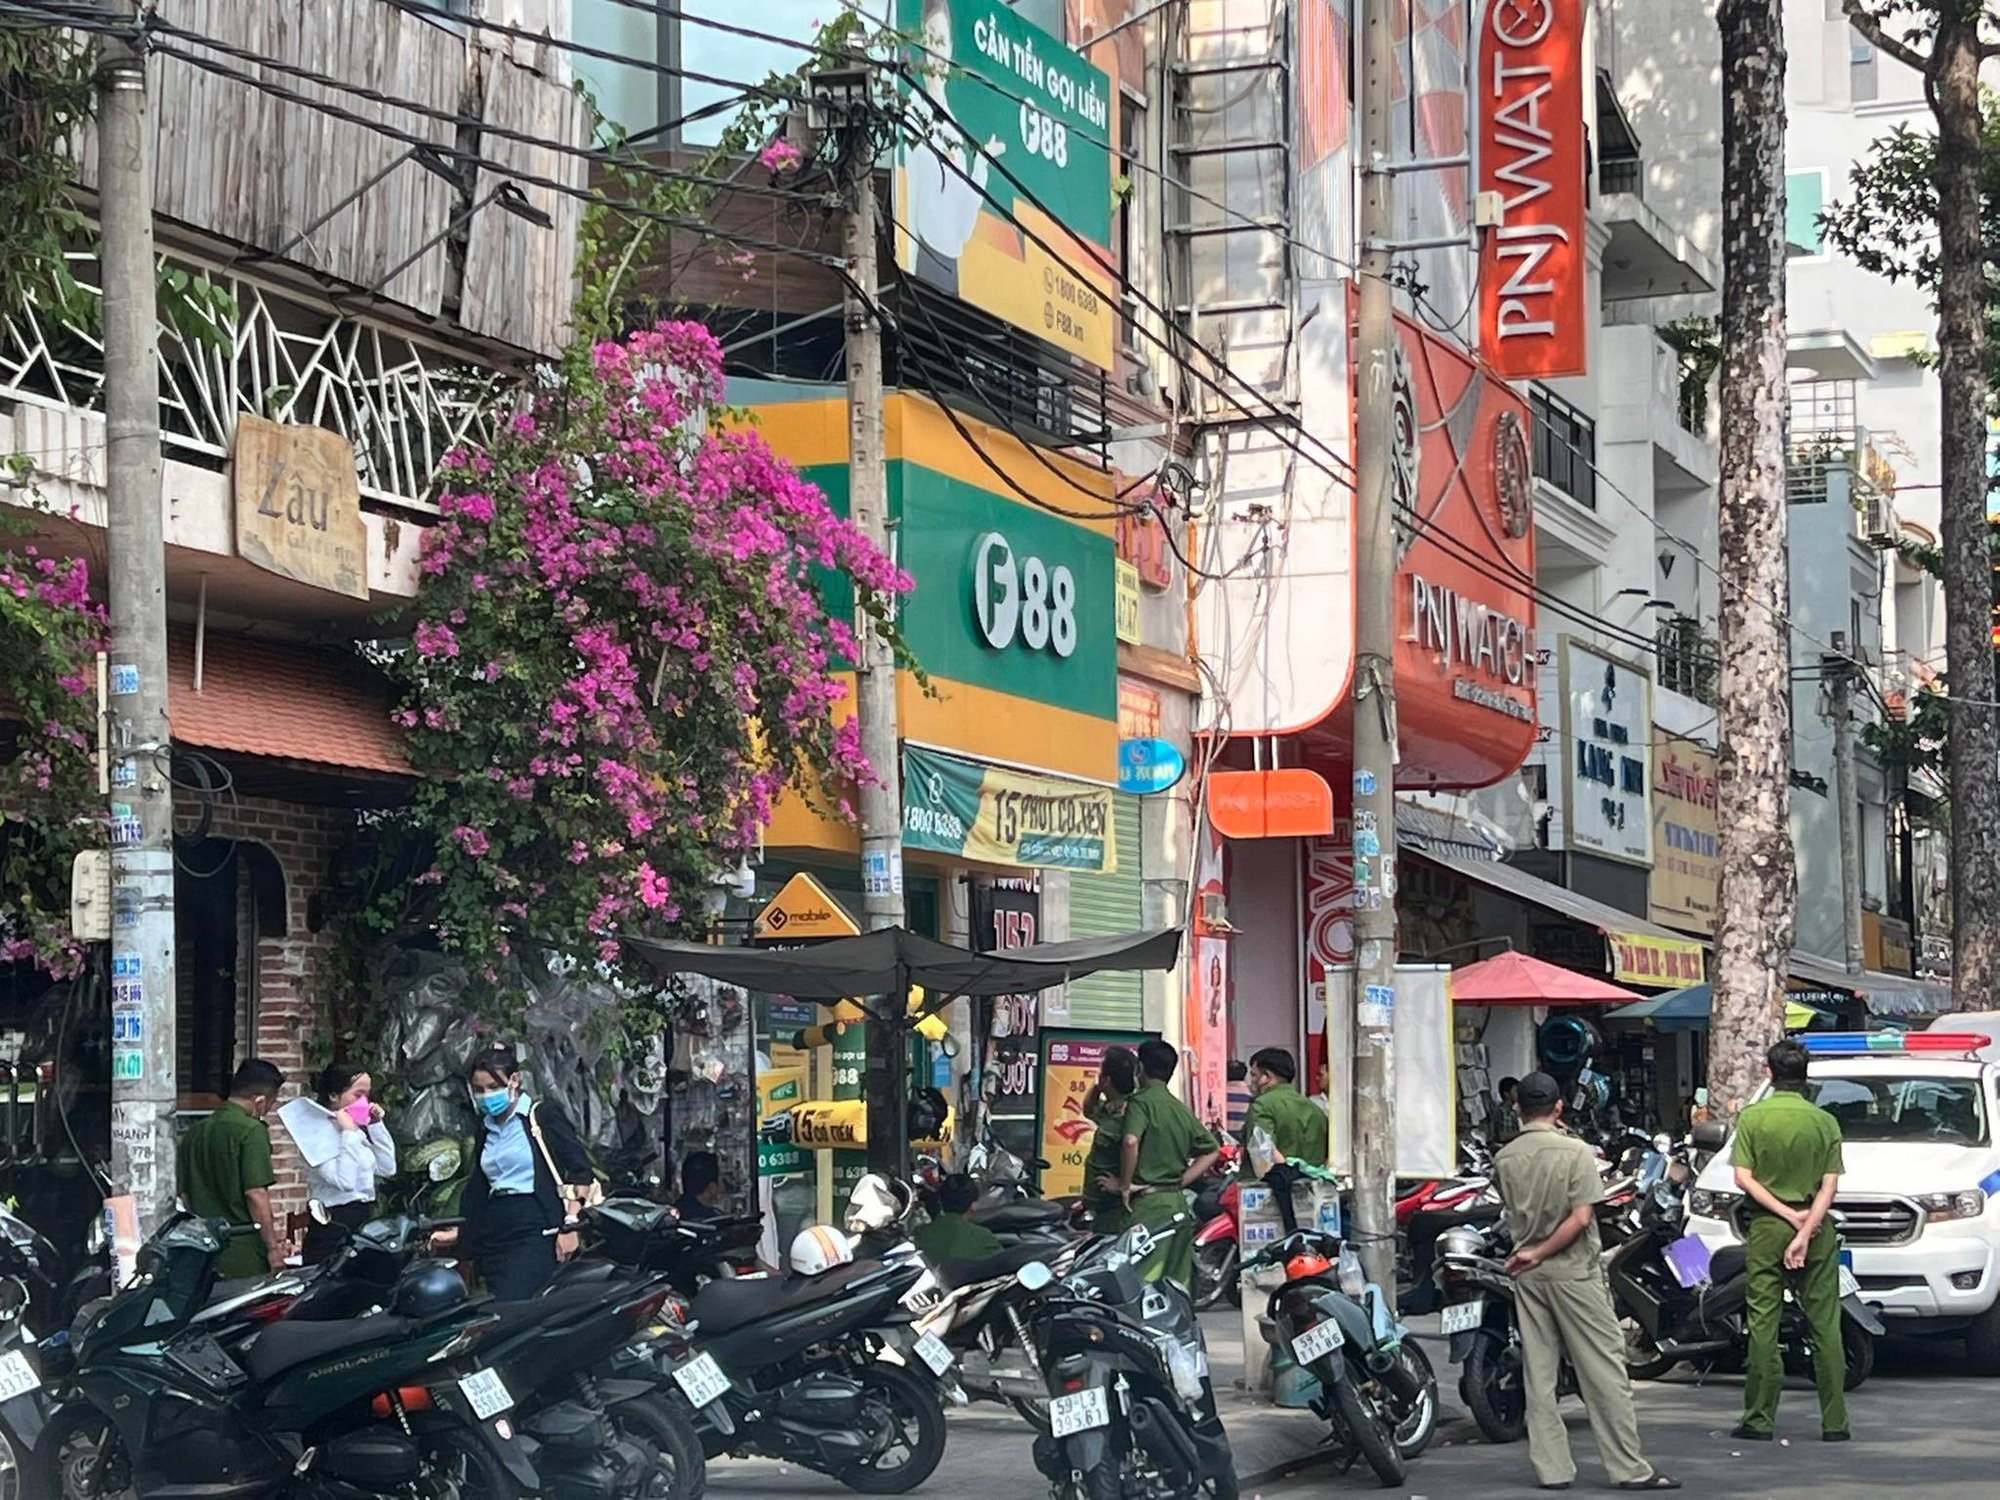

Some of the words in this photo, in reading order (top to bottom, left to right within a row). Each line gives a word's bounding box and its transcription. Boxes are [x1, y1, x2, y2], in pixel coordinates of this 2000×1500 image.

[1046, 66, 1075, 113] GỌI
[1496, 223, 1568, 339] PNJ
[974, 531, 1078, 657] F88
[1404, 573, 1452, 672] PNJ
[1453, 592, 1538, 689] WATCH
[994, 788, 1021, 845] 15
[793, 1110, 816, 1143] 15
